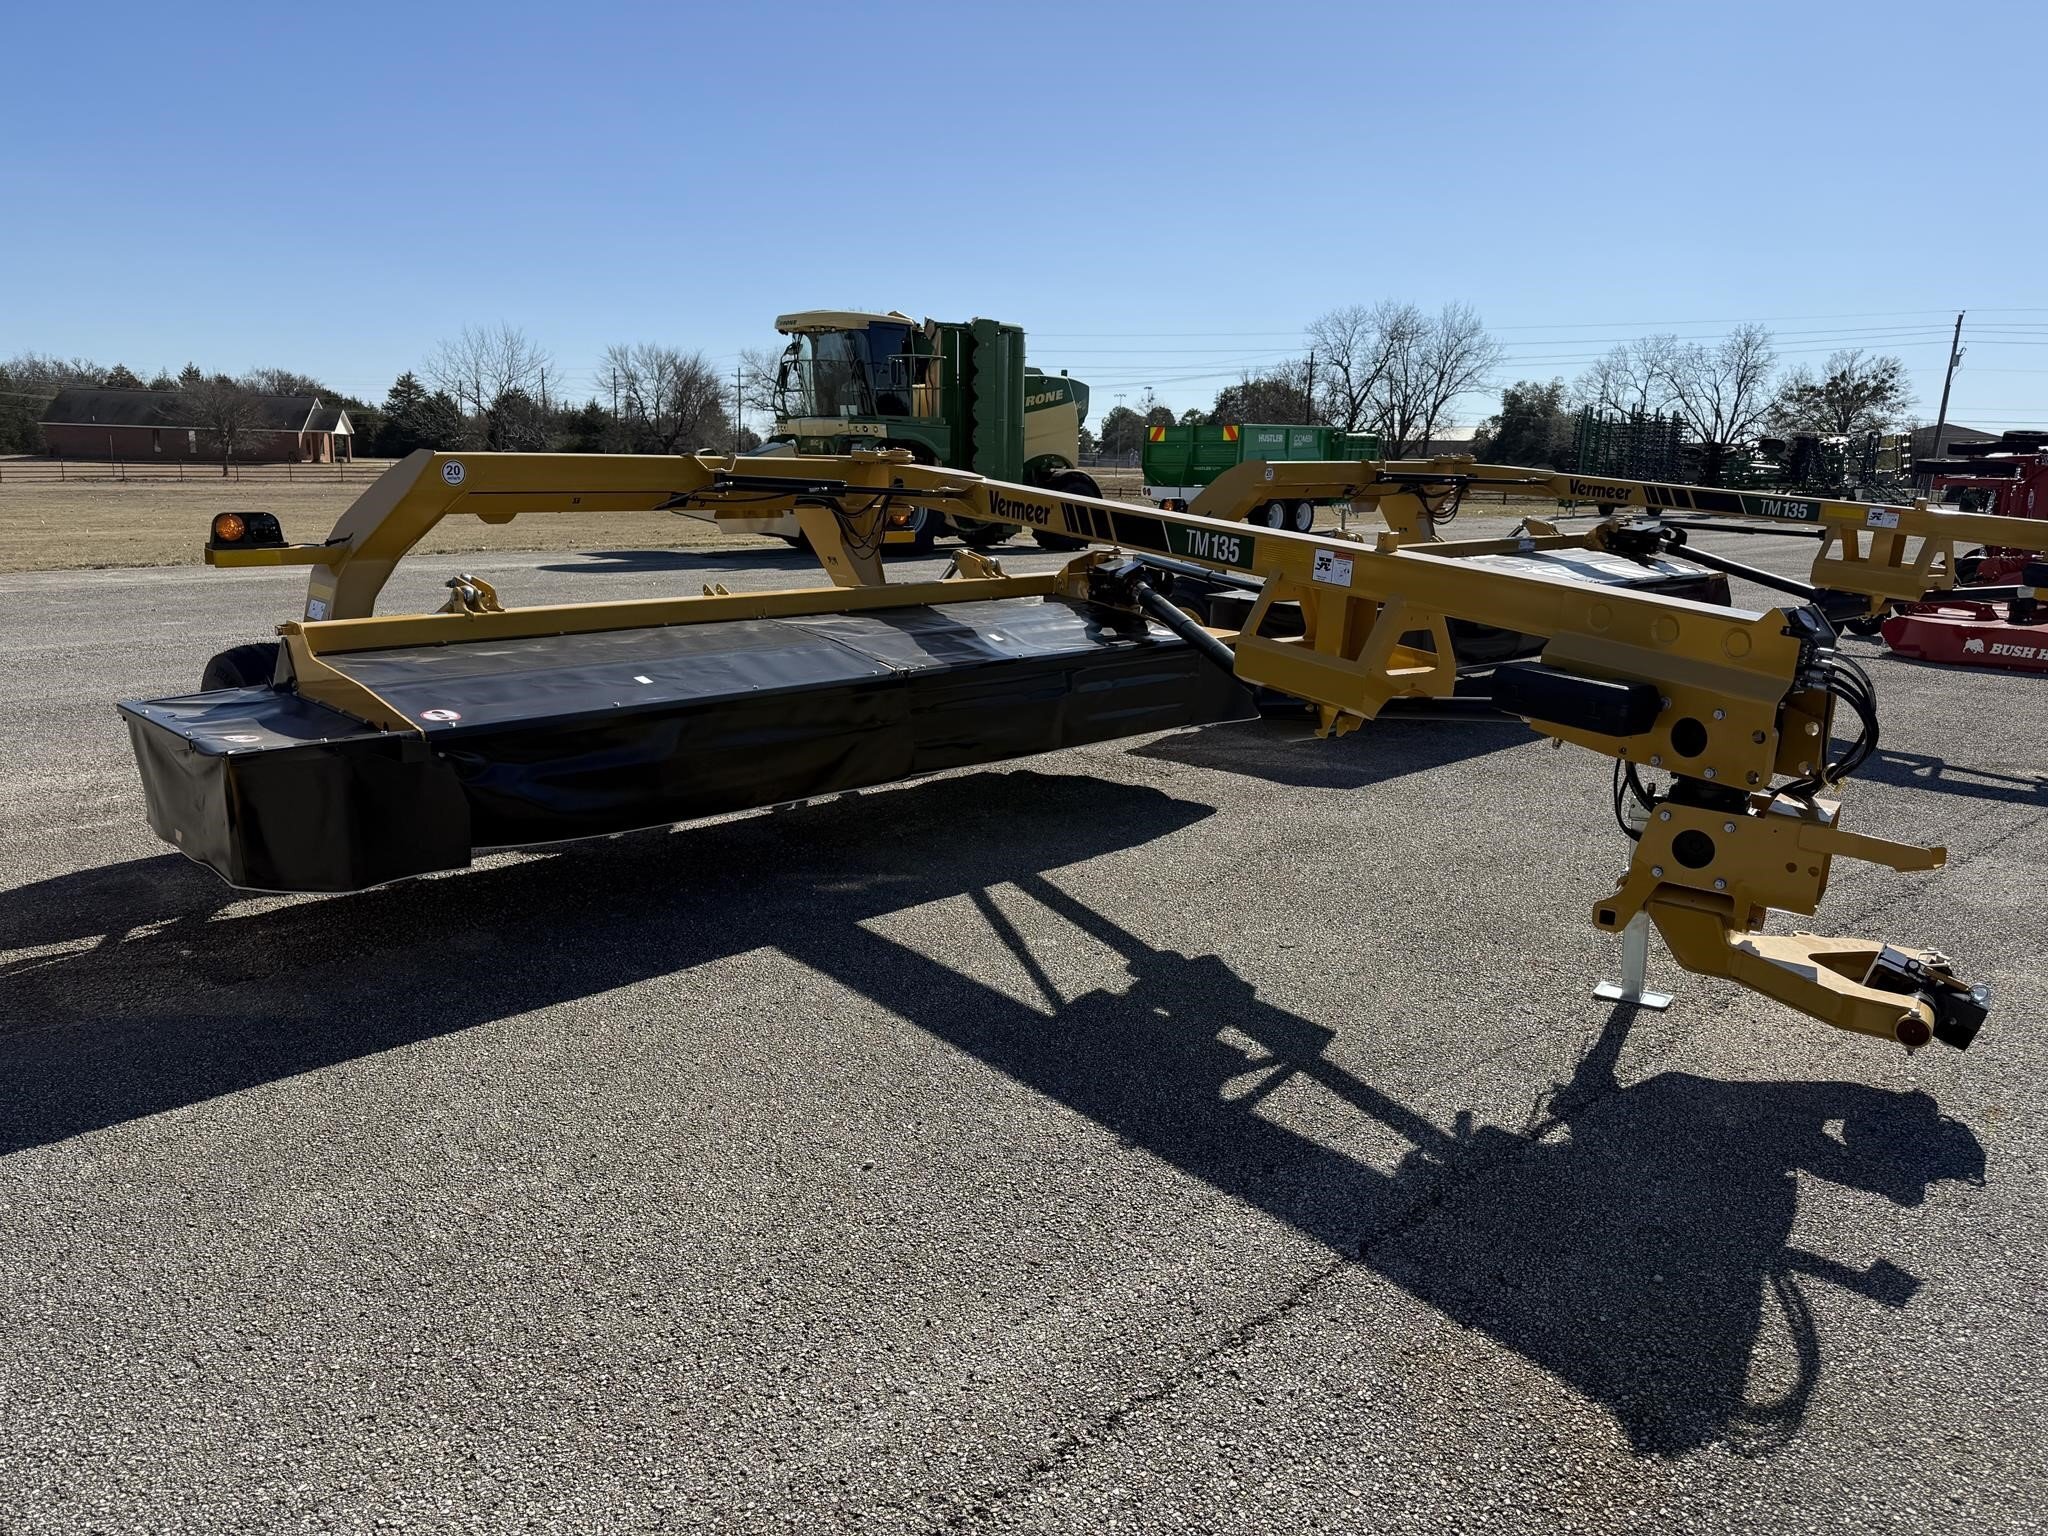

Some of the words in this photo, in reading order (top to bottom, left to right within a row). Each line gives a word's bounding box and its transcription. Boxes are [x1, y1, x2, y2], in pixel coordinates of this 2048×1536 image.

[1024, 389, 1064, 407] RONE
[446, 465, 461, 476] 20
[1569, 478, 1632, 500] Vermeer
[989, 489, 1051, 526] Vermeer
[1989, 643, 2037, 659] BUSH
